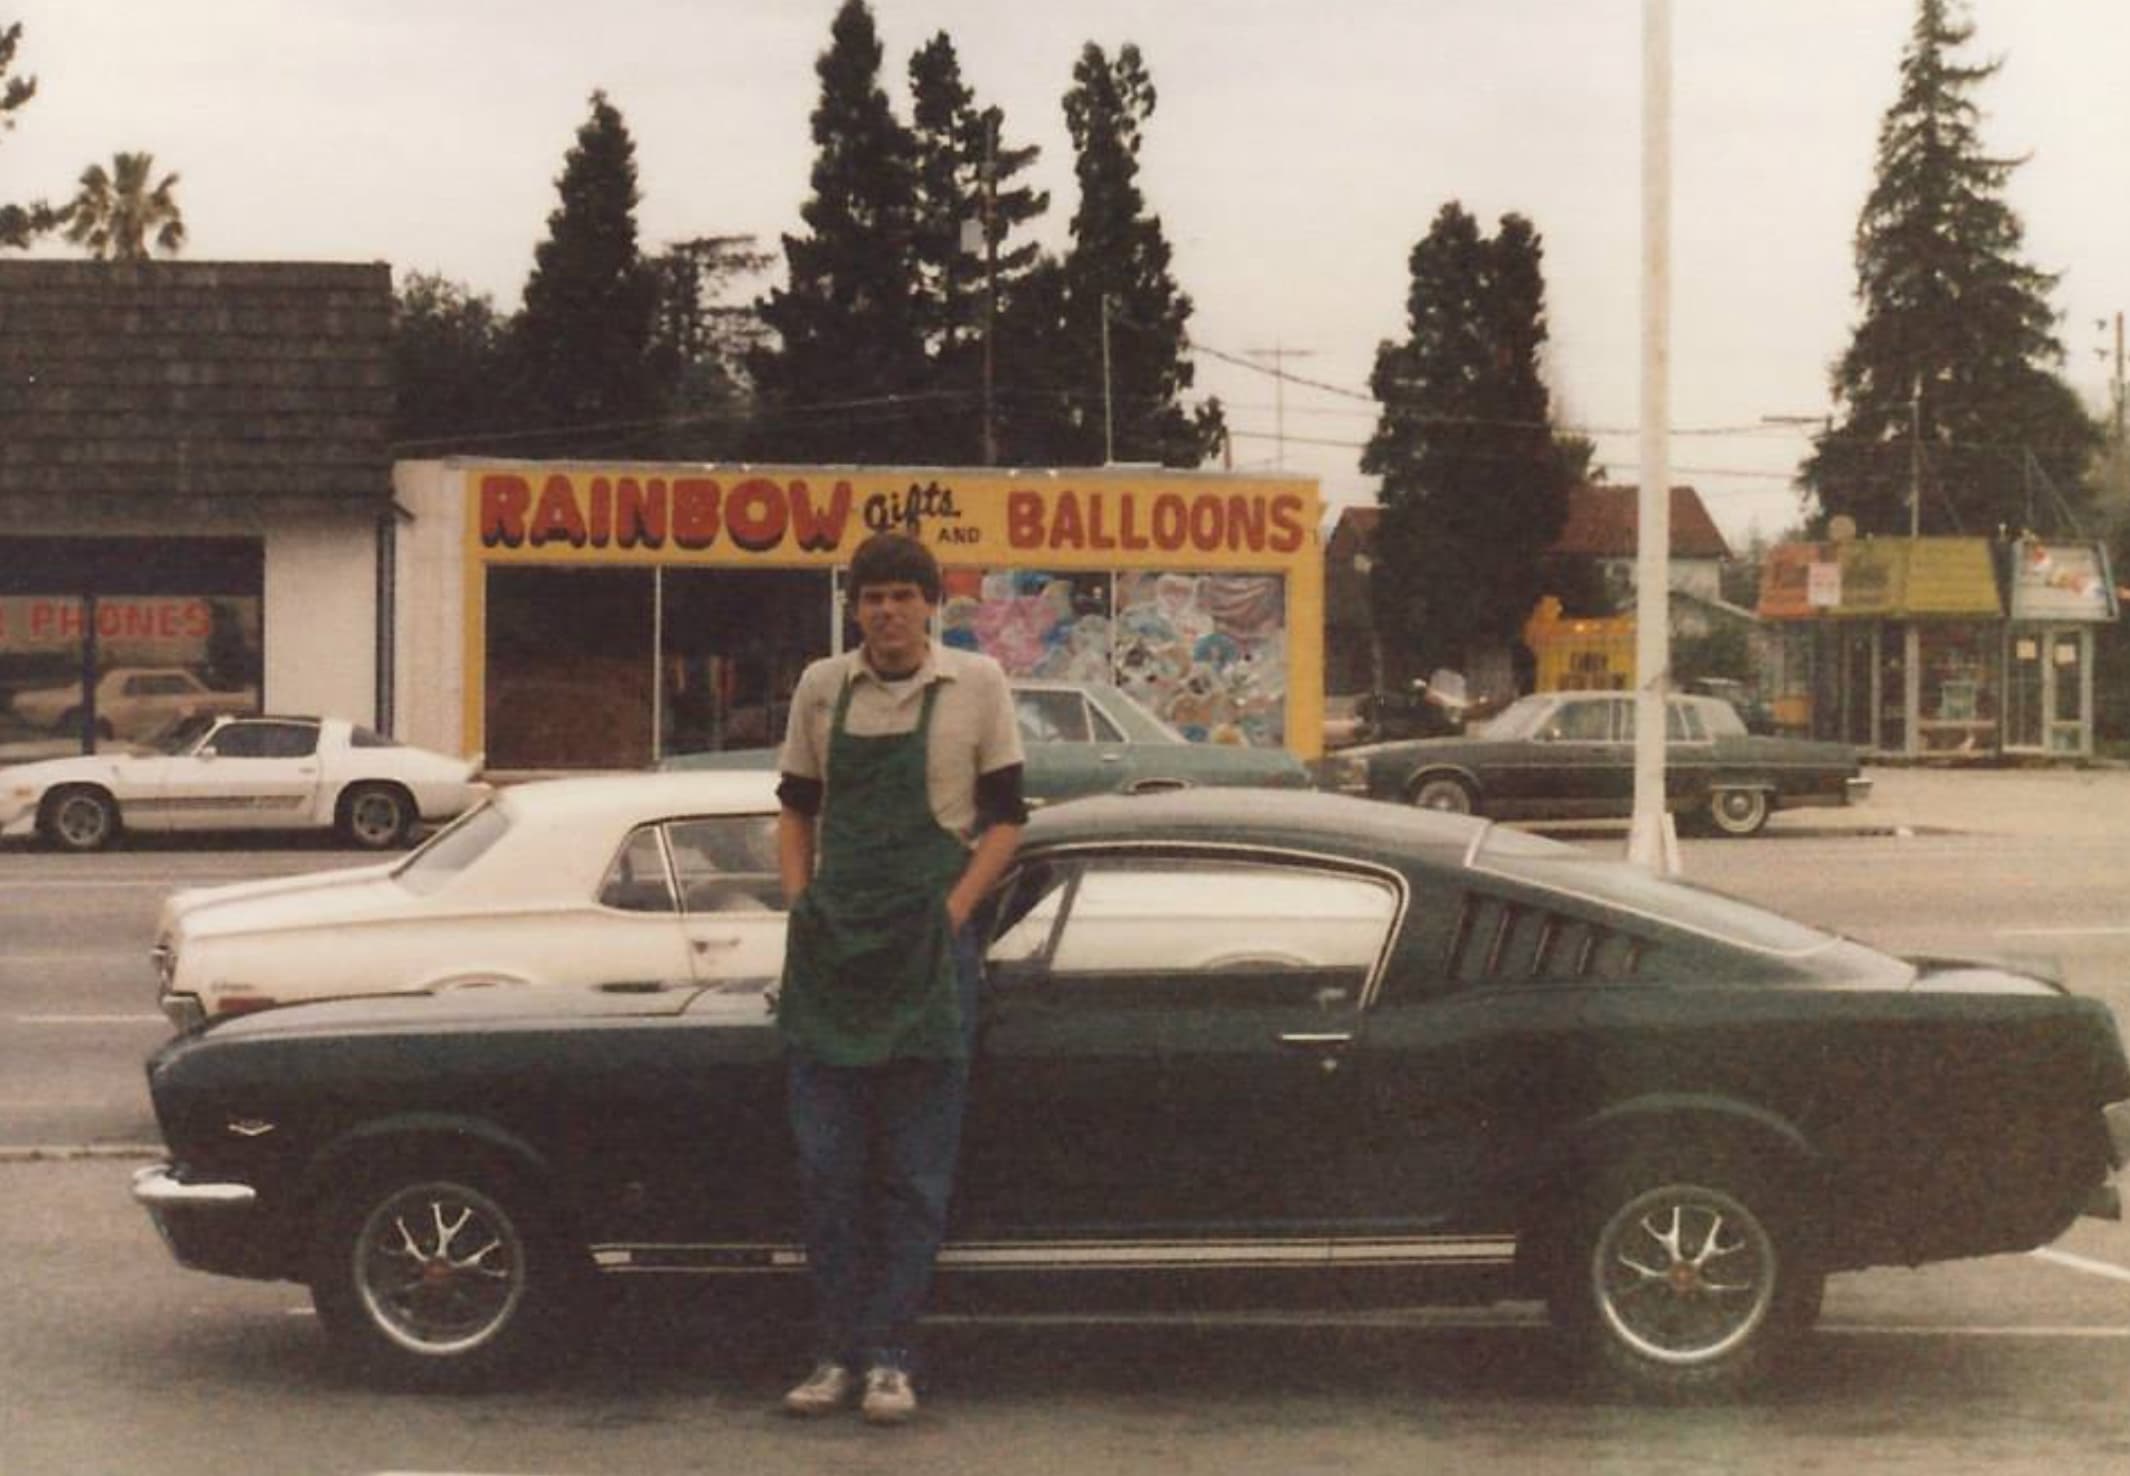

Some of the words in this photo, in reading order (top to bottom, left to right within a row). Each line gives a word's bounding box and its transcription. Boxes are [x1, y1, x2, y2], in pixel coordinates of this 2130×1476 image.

[481, 474, 852, 551] RAINBOW
[864, 481, 961, 537] Gifts
[939, 527, 980, 543] AND
[1006, 491, 1304, 553] BALLOONS
[31, 602, 210, 637] PHONES
